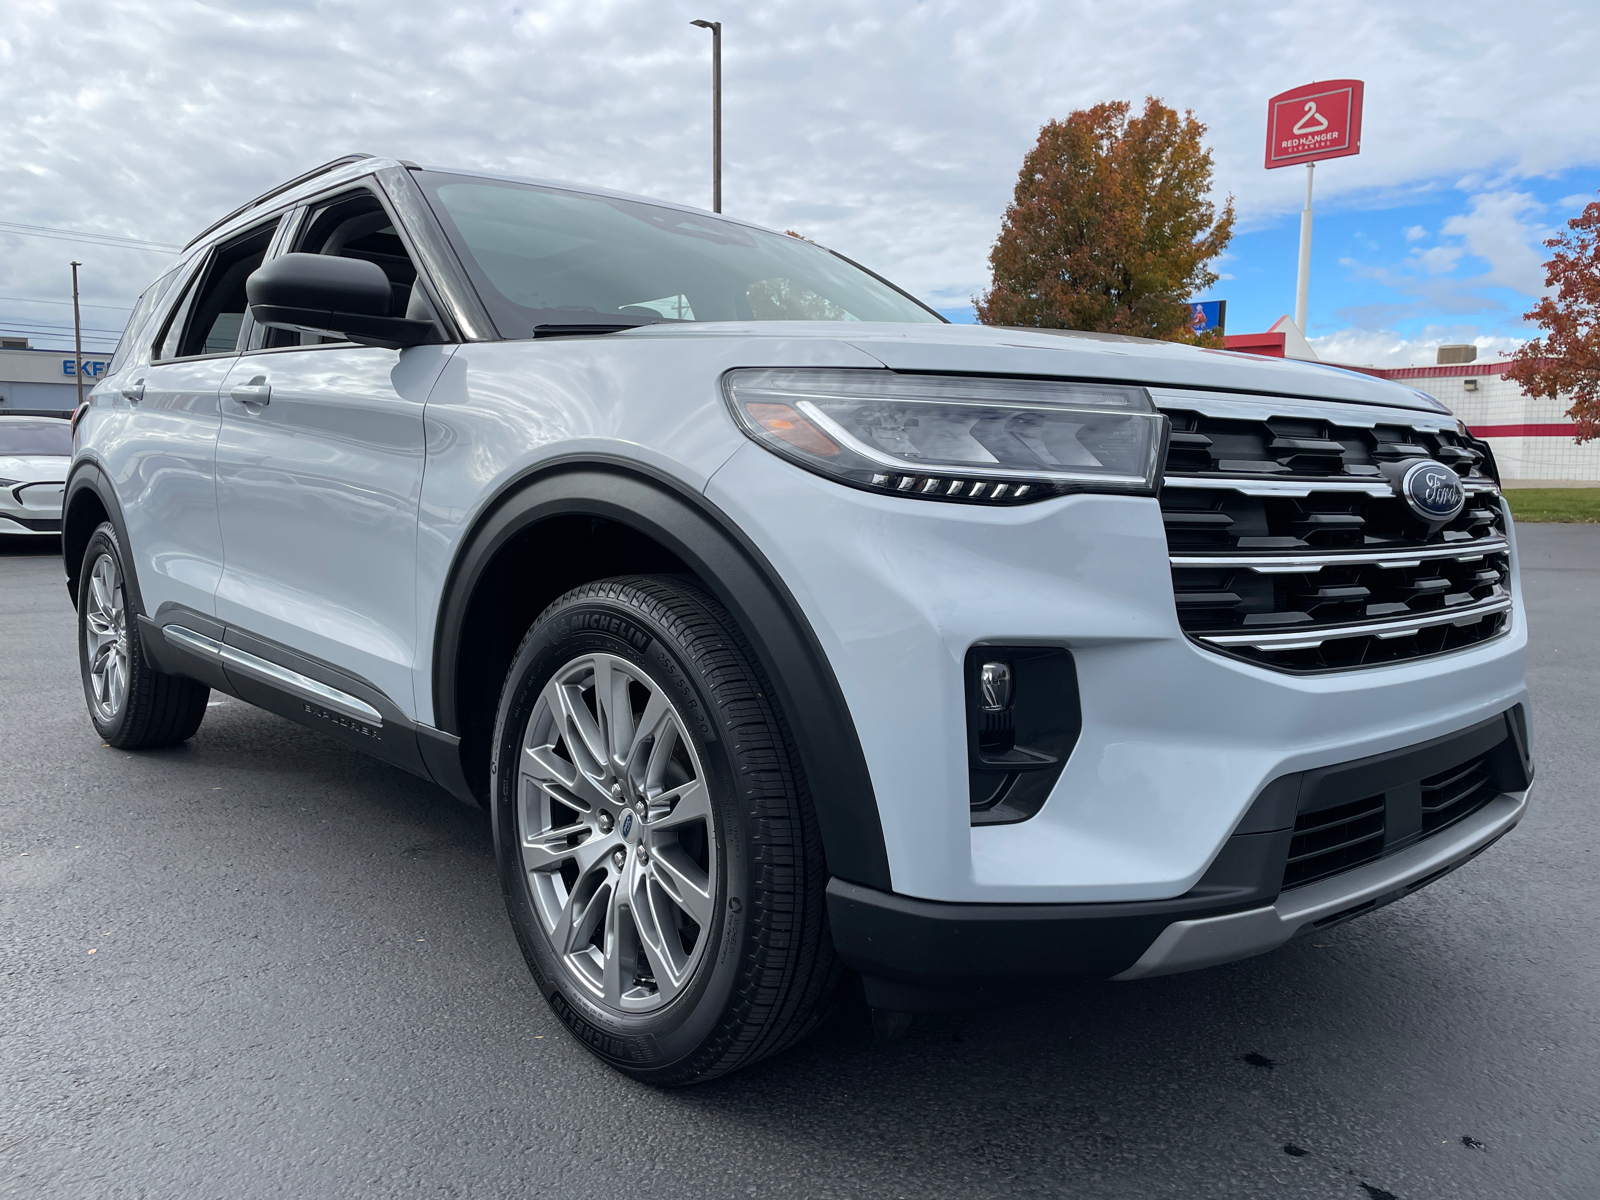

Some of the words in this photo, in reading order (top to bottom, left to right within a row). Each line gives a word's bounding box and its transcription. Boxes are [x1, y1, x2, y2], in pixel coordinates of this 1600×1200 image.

[1288, 141, 1331, 153] CLEANERS
[1425, 472, 1460, 505] Ford
[571, 612, 647, 648] MICHELIN
[656, 652, 690, 696] 255/55
[687, 699, 698, 710] R
[695, 714, 709, 733] 20
[552, 996, 624, 1056] MICHELIN
